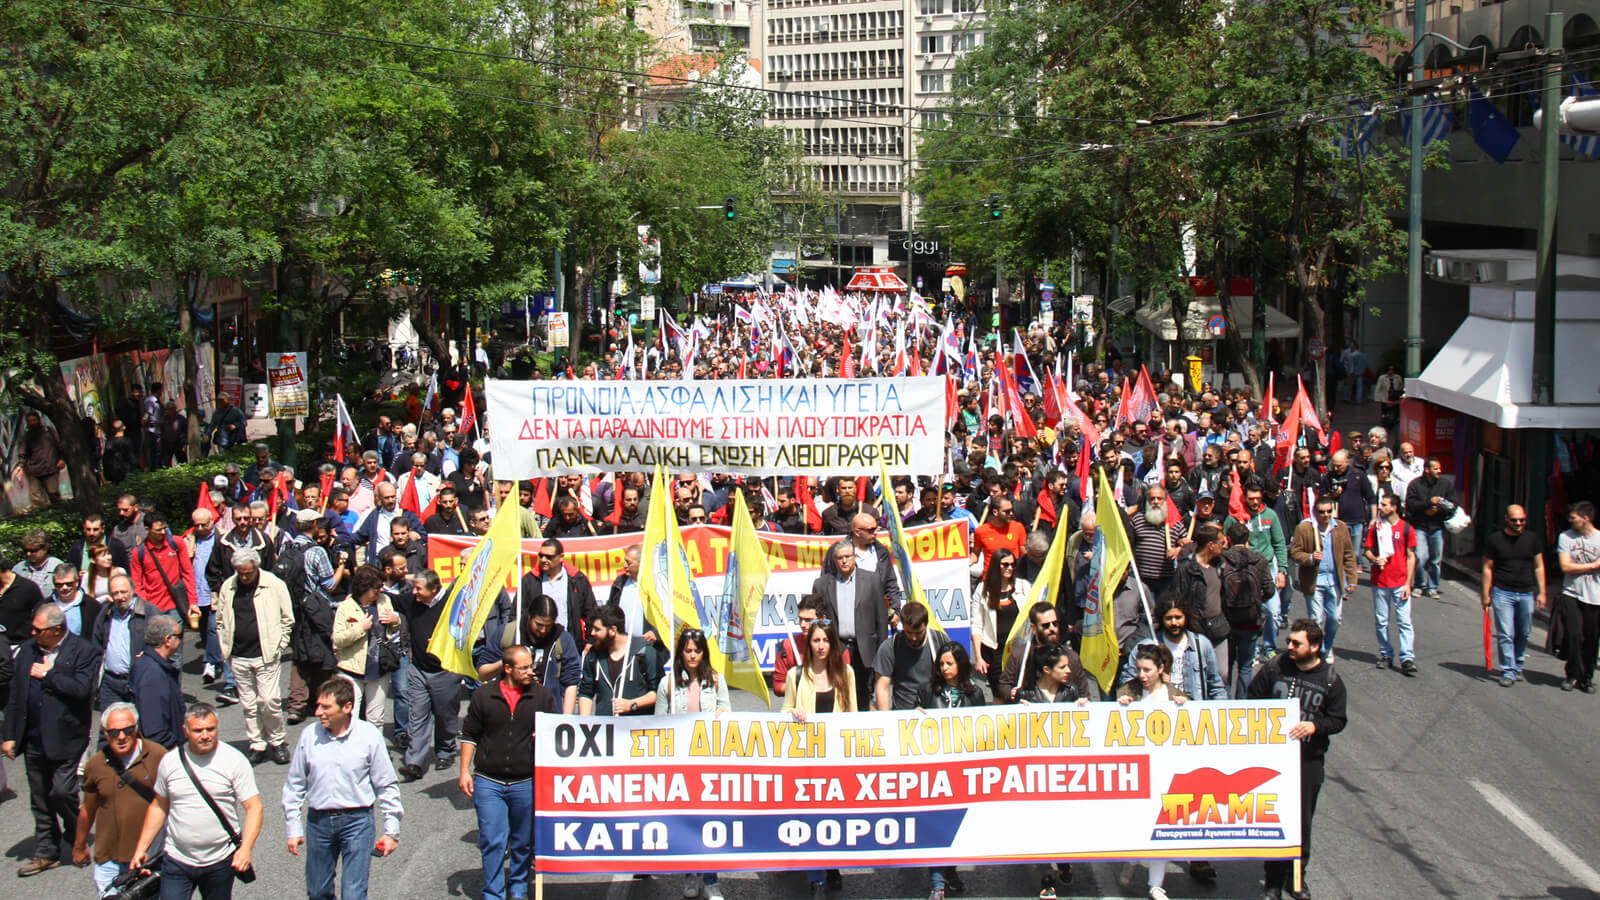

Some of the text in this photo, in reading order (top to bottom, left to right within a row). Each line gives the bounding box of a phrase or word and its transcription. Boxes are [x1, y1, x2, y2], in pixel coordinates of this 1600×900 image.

[902, 240, 939, 255] oggi
[779, 384, 818, 413] ΚΑΙ
[826, 383, 903, 412] ΥΓΕΙΑ
[518, 414, 928, 441] ΔΕΝ ΤΑ ΠΑΡΑΔΙΝΟΥΜΕ ΣΤΗΝ ΠΛΟΥΤΟΚΡΑΤΙΑ
[536, 443, 909, 470] ΠΑΝΕΛΛΑΔΙΚΗ ΕΝΩΣΗ ΛΙΘΟΓΡΑΦΩΝ
[554, 707, 1287, 759] ΟΧΙ ΣΤΗ ΔΙΑΛΥΣΗ ΤΗΣ ΚΟΙΝΩΝΙΚΗΣ ΑΣΦΑΛΙΣΗΣ
[553, 762, 1140, 804] ΚΑΝΕΝΑ ΣΠΙΤΙ ΣΤΑ ΧΕΡΙΑ ΤΡΑΠΕΖΙΤΗ
[553, 816, 916, 851] ΚΑΤΩ ΟΙ ΦΟΡΟΙ
